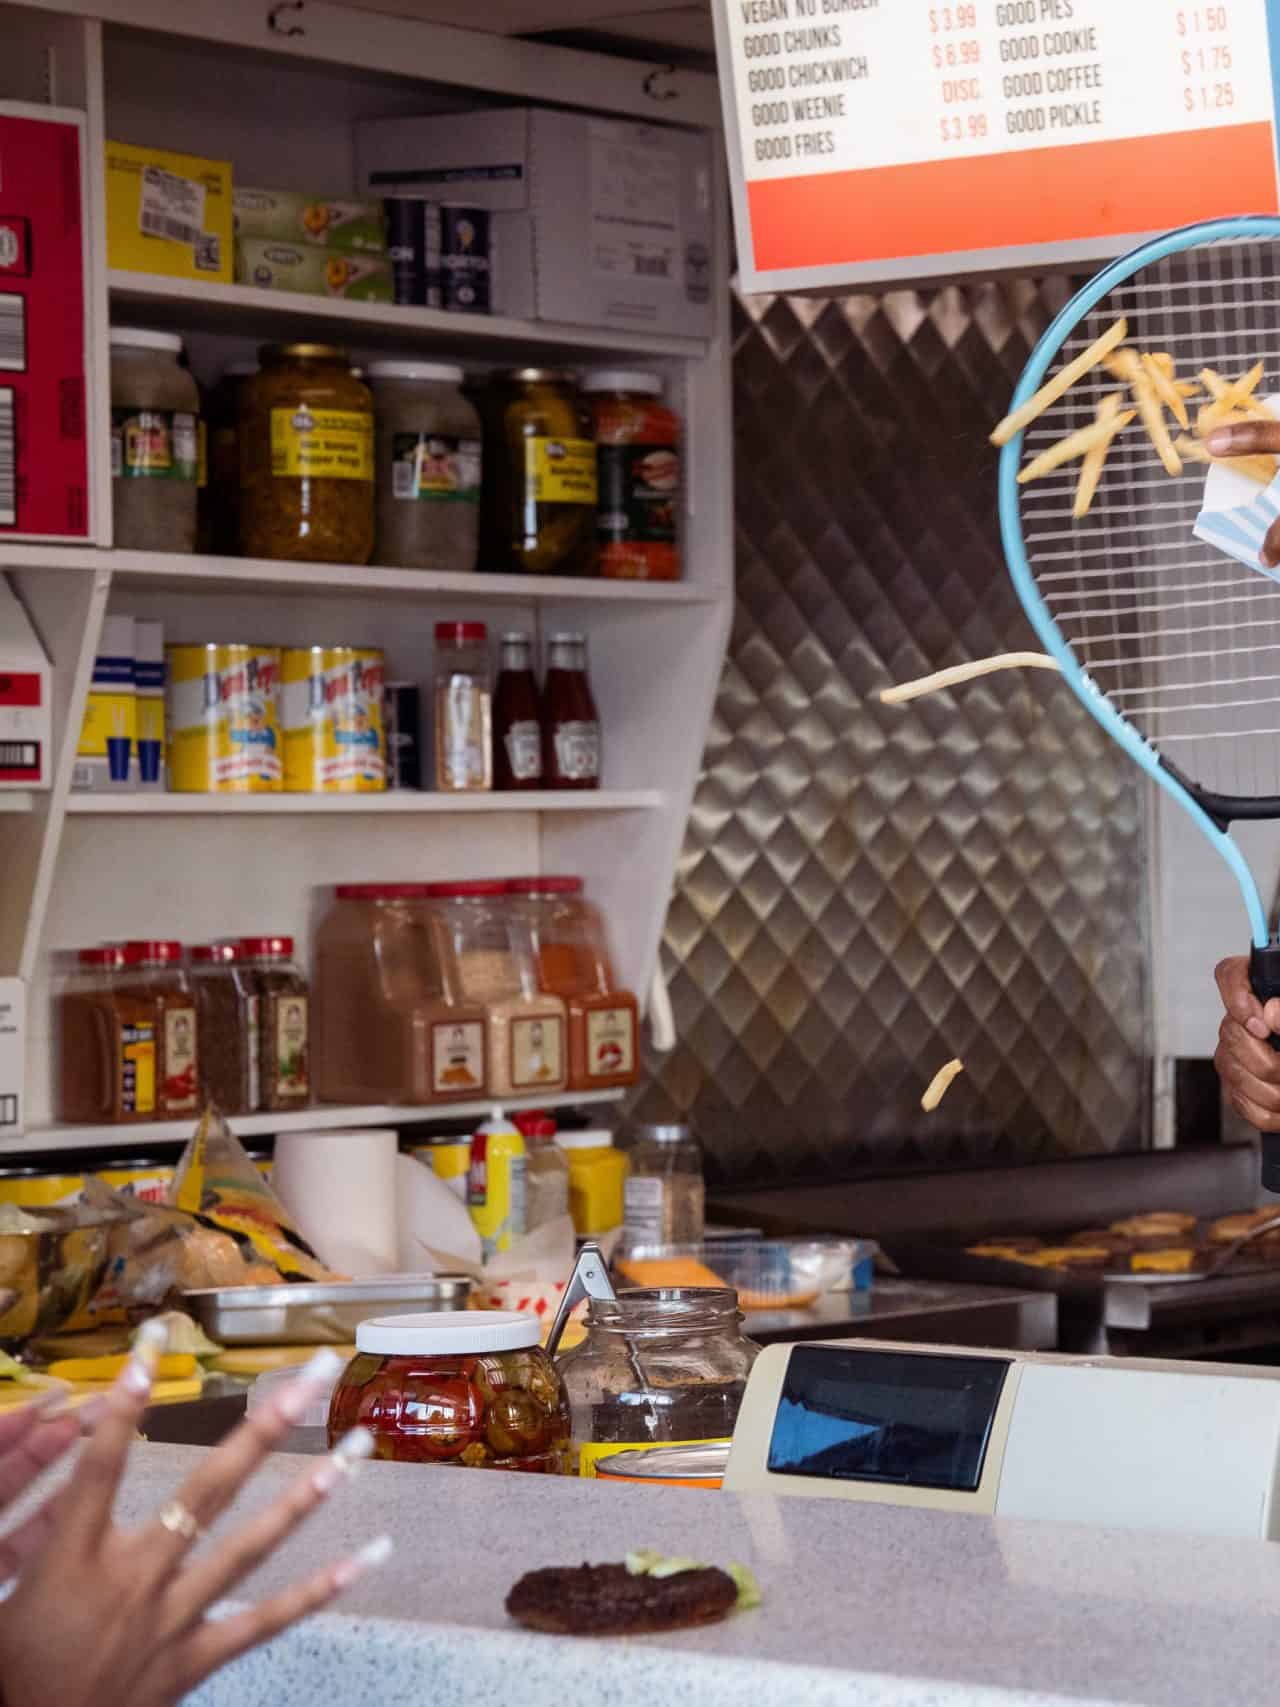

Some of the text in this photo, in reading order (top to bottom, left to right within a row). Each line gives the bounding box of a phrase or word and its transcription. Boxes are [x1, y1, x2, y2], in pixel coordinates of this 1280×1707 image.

[996, 0, 1074, 27] GOOD PIES
[743, 24, 841, 59] GOOD CHUNKS
[999, 27, 1097, 62] GOOD COOKIE
[748, 56, 868, 93] GOOD CHICKWICH
[1002, 63, 1103, 99] GOOD COFFEE
[751, 94, 846, 127] GOOD WEENIE
[1006, 100, 1103, 134] GOOD PICKLE
[754, 131, 835, 161] GOOD FRIES
